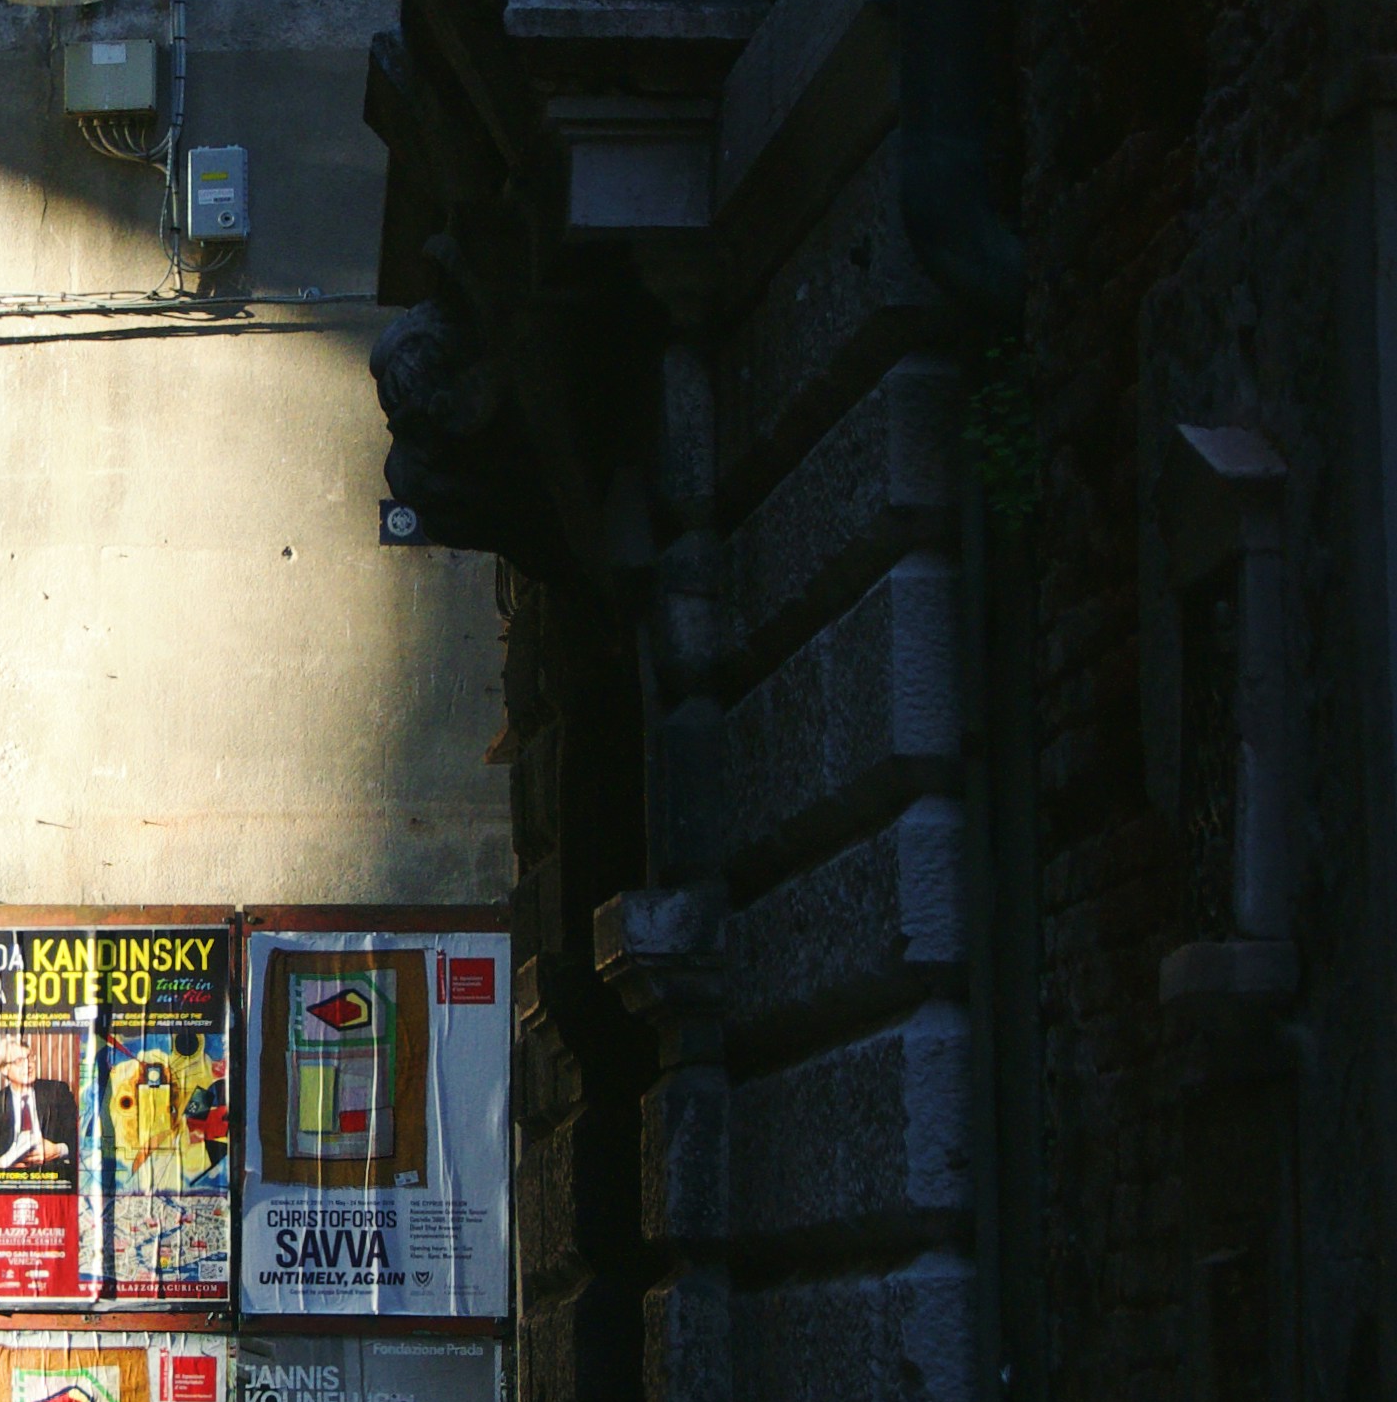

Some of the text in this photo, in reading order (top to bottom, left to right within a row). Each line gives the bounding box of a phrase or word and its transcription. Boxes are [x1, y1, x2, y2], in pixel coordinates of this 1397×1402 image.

[33, 938, 215, 972] KANDINSKY
[15, 972, 152, 1005] BOTERO
[267, 1210, 397, 1228] CHRISTOFOROS
[276, 1229, 390, 1268] SAVVA
[259, 1271, 406, 1286] UNTIMELY, AGAIN
[372, 1343, 484, 1356] Fondazione Prada
[244, 1365, 340, 1390] JANNIS
